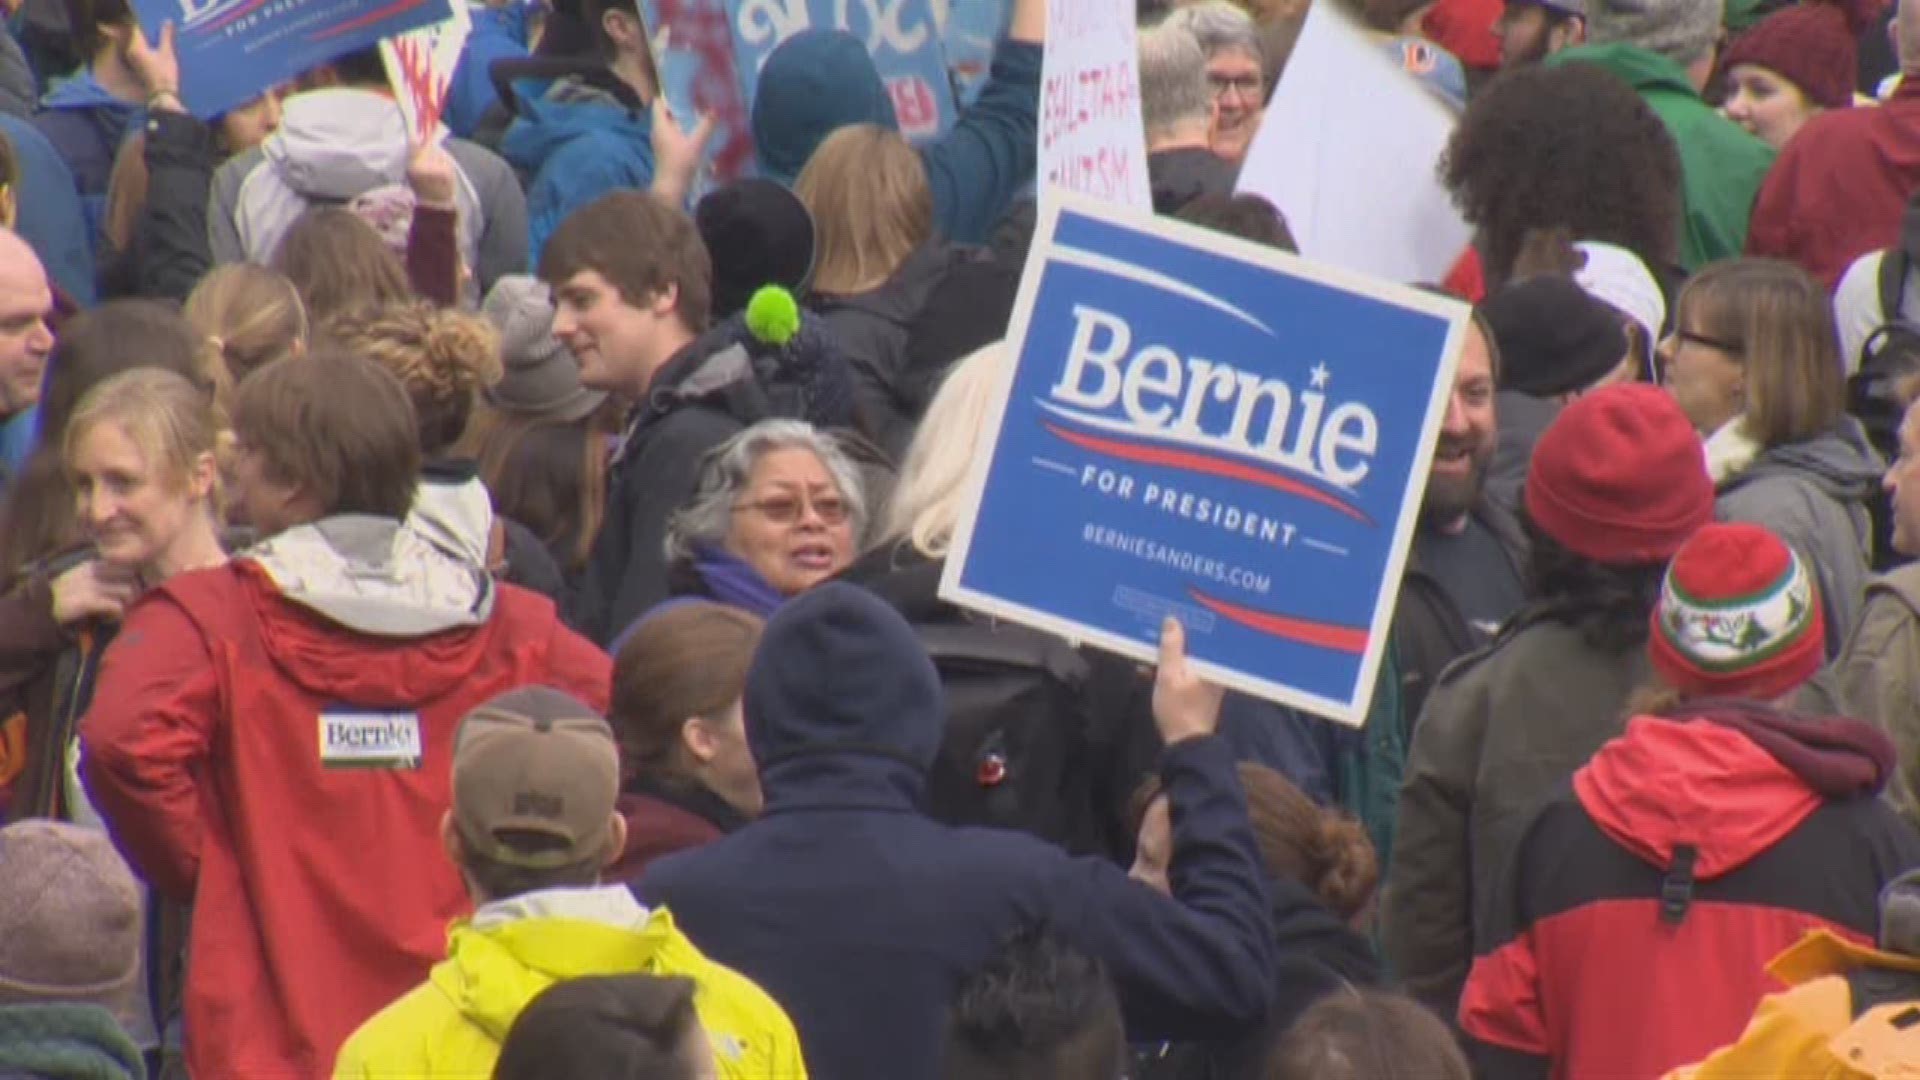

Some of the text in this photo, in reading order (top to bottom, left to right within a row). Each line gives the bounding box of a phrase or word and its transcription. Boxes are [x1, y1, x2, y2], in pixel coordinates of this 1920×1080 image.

[1051, 302, 1379, 486] Bernie
[1081, 464, 1298, 546] FOR PRESIDENT
[1083, 522, 1272, 594] BERNIESANDERS.COM
